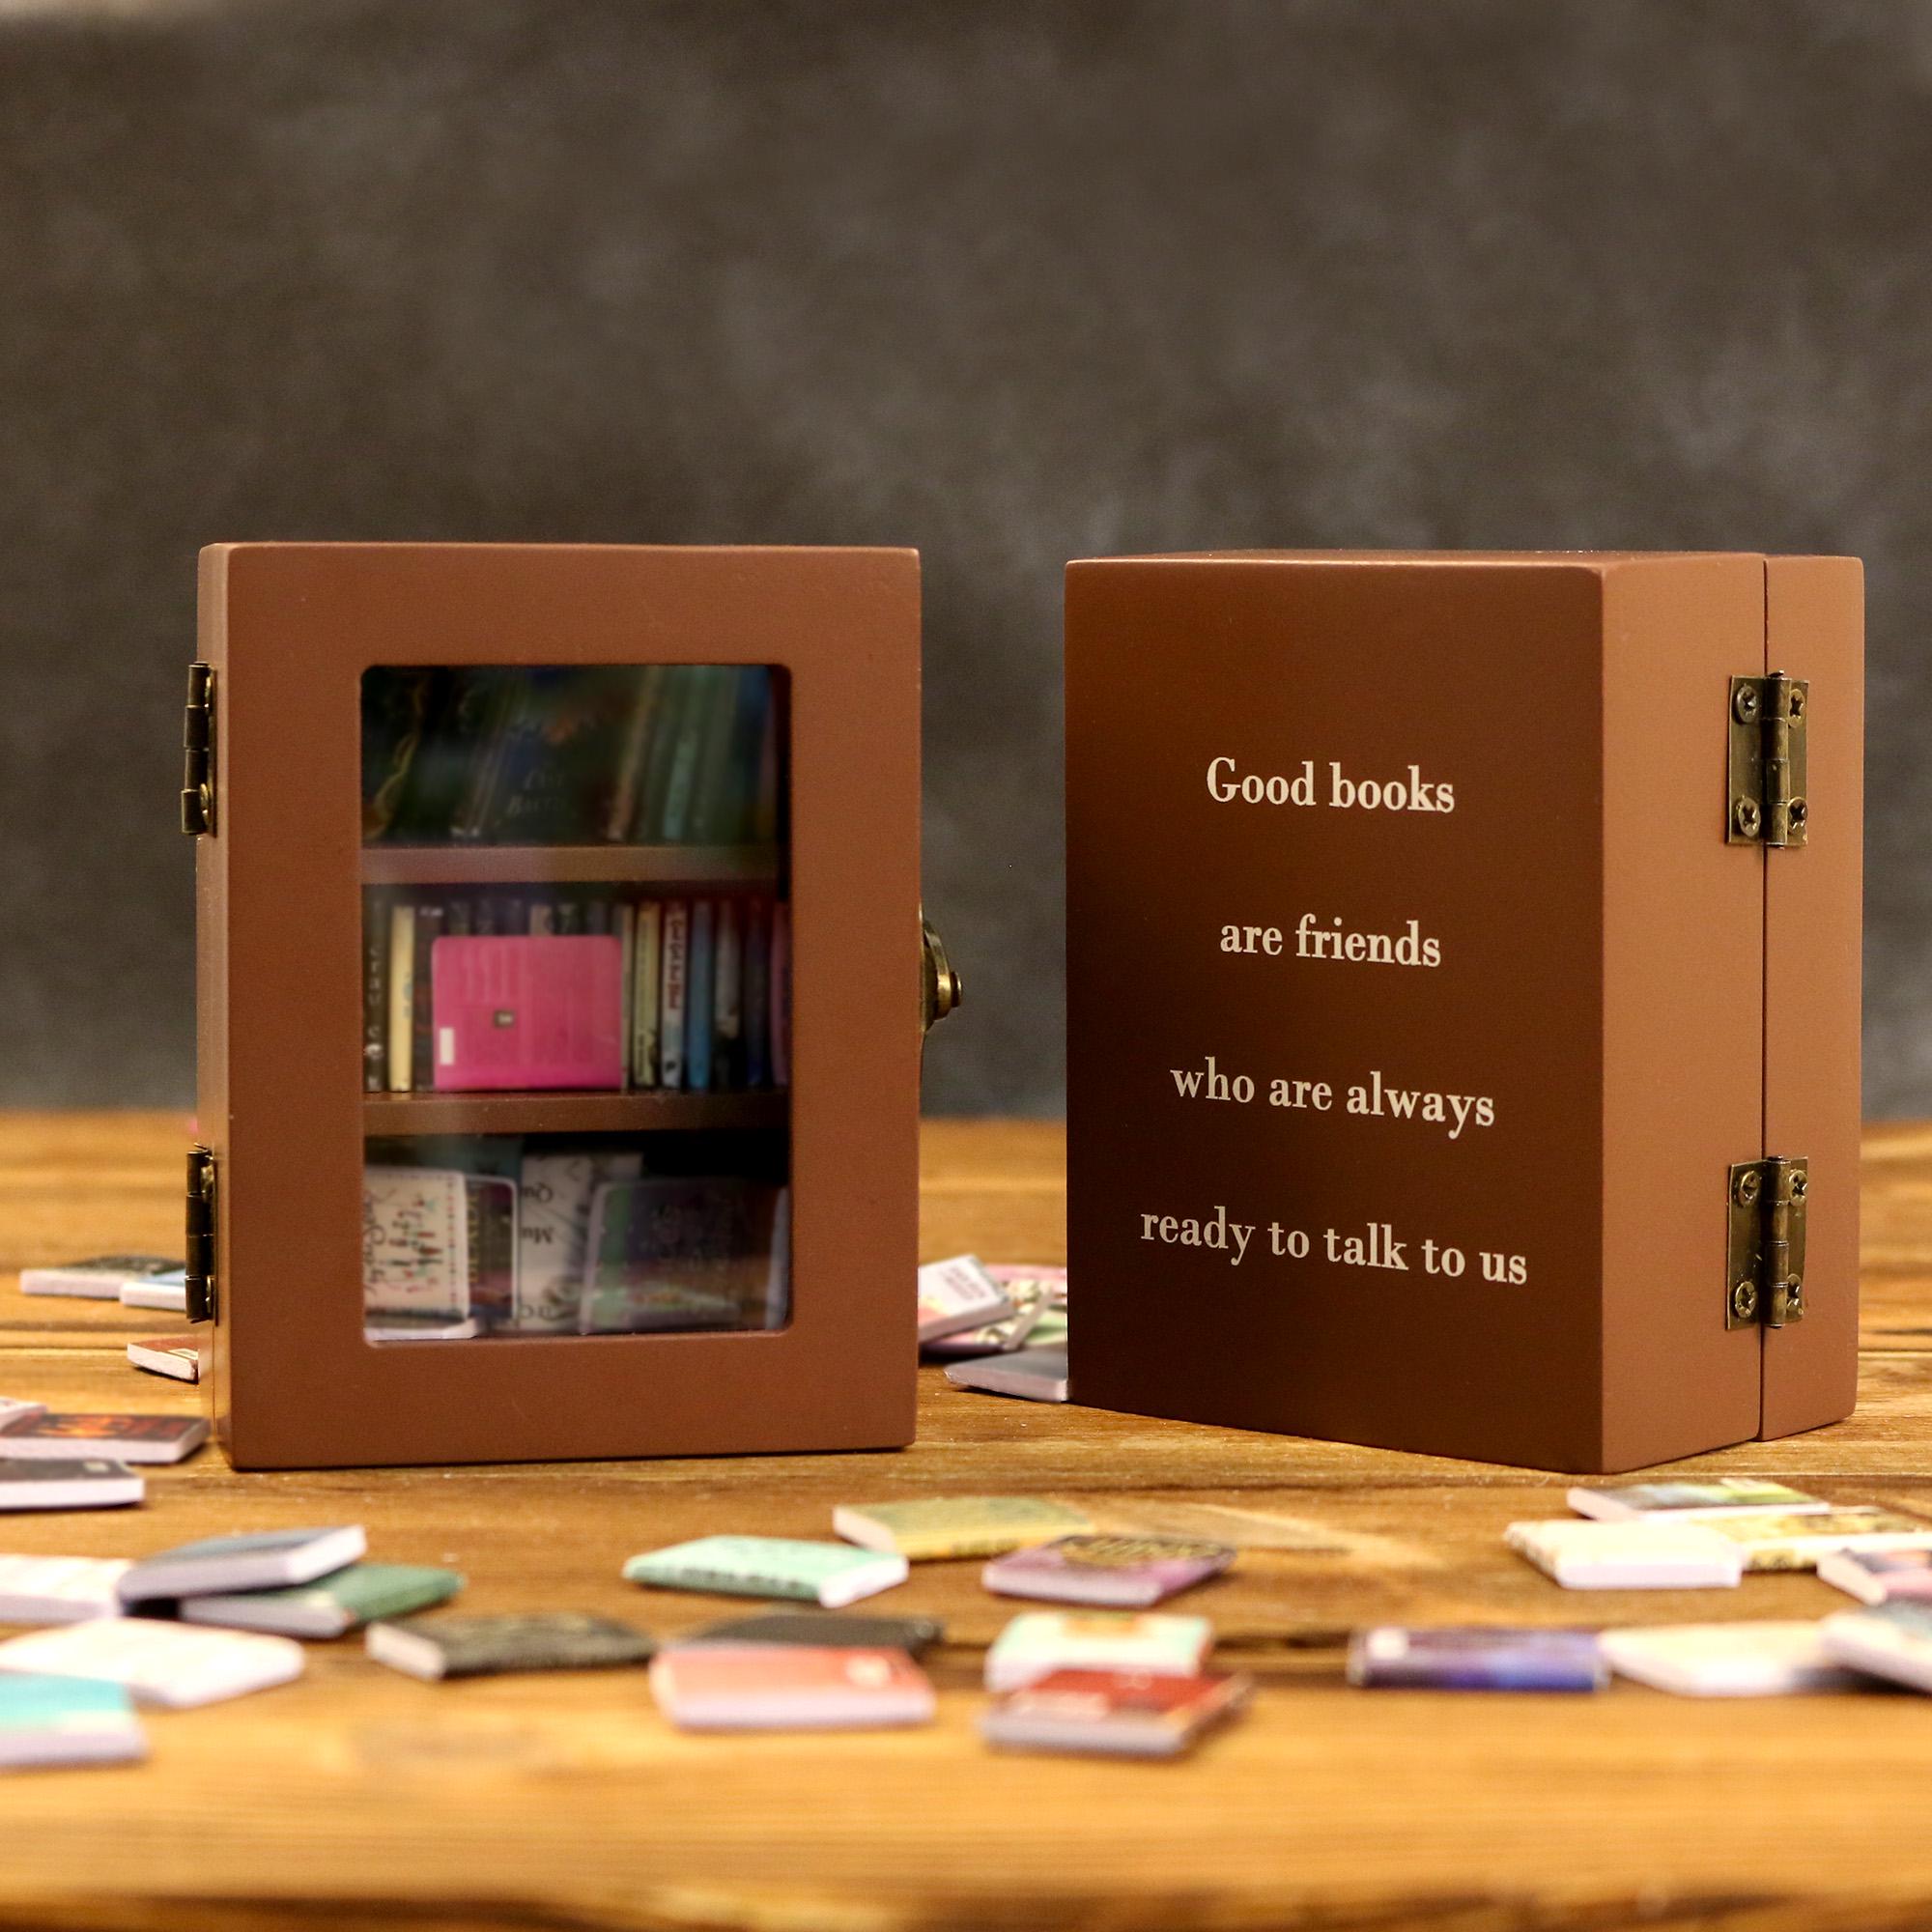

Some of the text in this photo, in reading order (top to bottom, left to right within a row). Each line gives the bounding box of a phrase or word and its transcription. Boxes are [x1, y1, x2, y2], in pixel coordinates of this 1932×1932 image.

[1207, 756, 1455, 813] Good books
[1220, 913, 1441, 967] are friends
[1170, 1056, 1494, 1140] who are always
[1140, 1206, 1527, 1285] ready to talk to us
